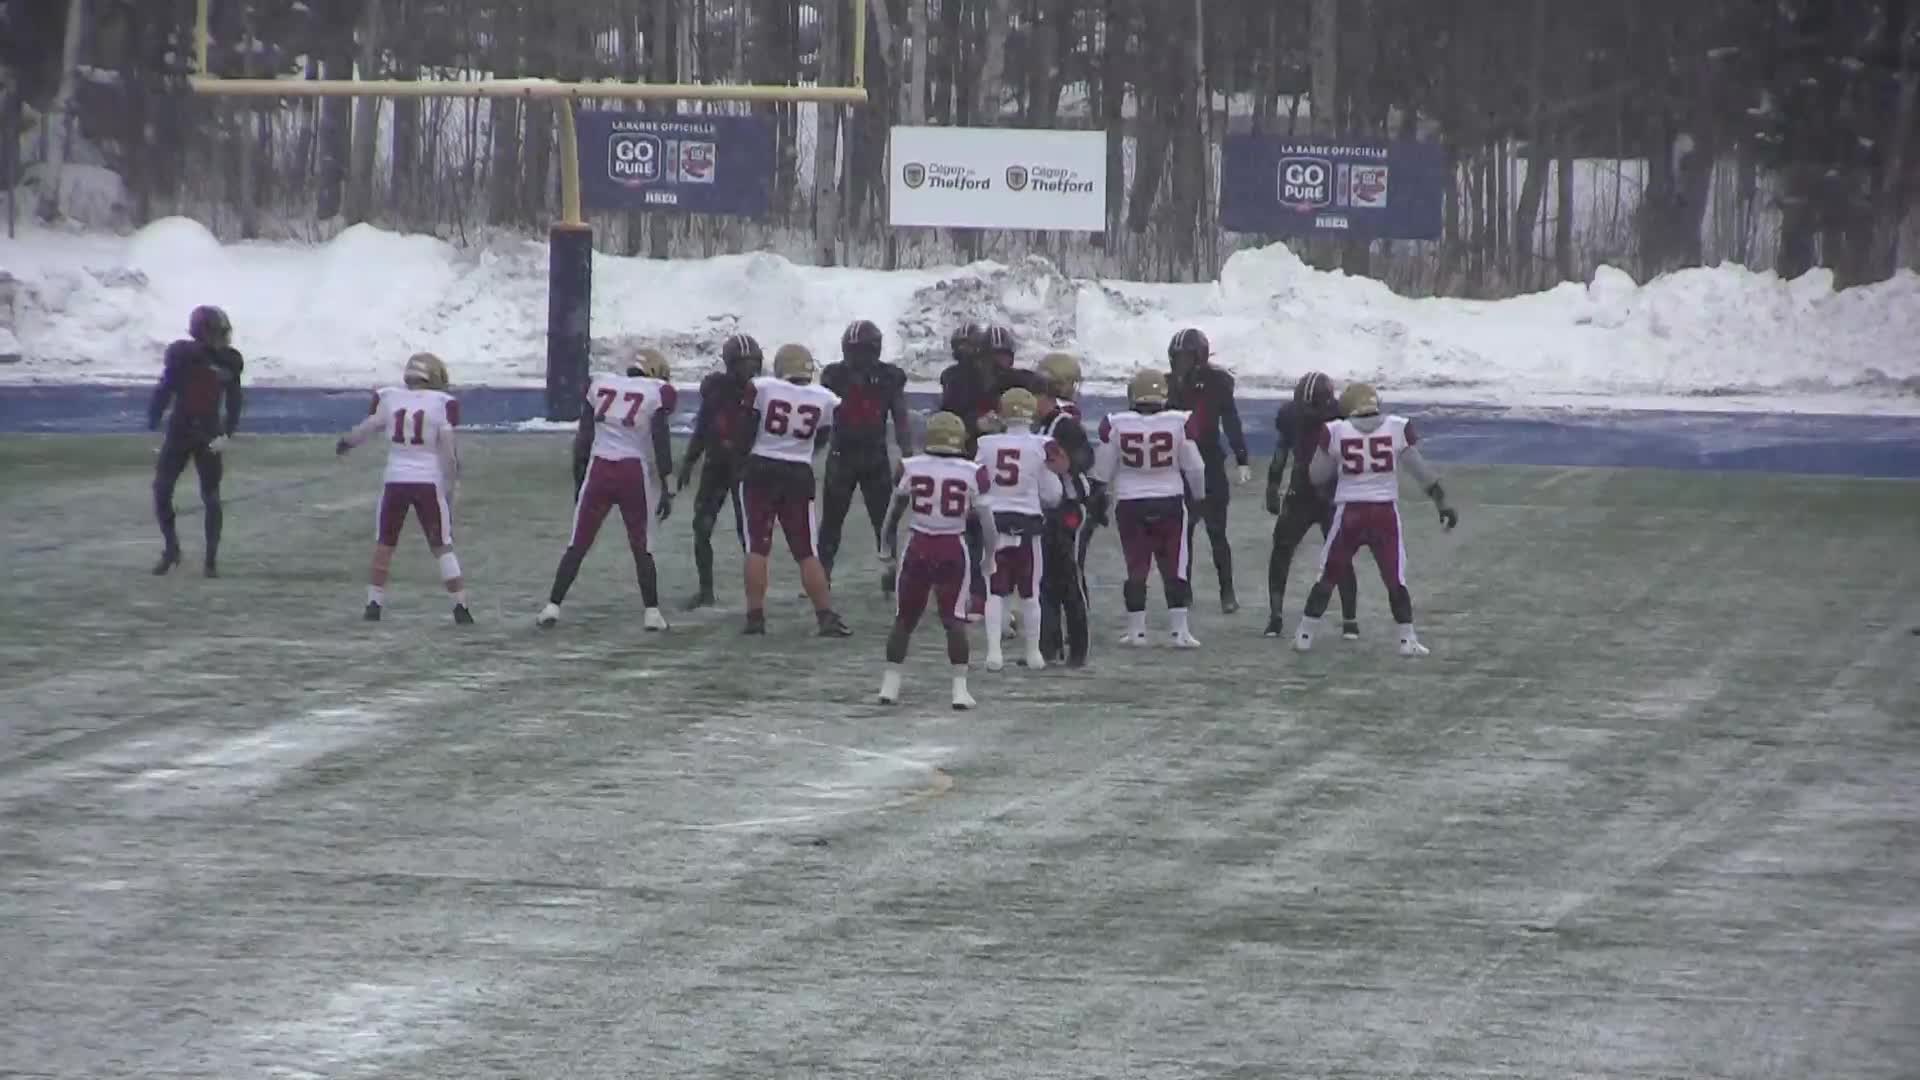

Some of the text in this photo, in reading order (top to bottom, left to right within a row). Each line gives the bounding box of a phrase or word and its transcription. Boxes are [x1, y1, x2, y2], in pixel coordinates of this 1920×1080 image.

[661, 122, 716, 133] OFFICIELLE
[616, 140, 653, 161] GO
[1281, 145, 1388, 157] LA BARRE OFFICIELLE
[615, 160, 654, 175] PURE
[1286, 164, 1324, 185] GO
[928, 175, 991, 191] Thetford
[1031, 178, 1094, 194] Thetford
[1285, 184, 1324, 199] PURE
[595, 387, 645, 427] 77
[392, 408, 424, 446] 11
[763, 398, 822, 440] 63
[1120, 431, 1173, 469] 52
[1340, 435, 1395, 475] 55
[995, 448, 1021, 487] 5
[910, 475, 968, 518] 26
